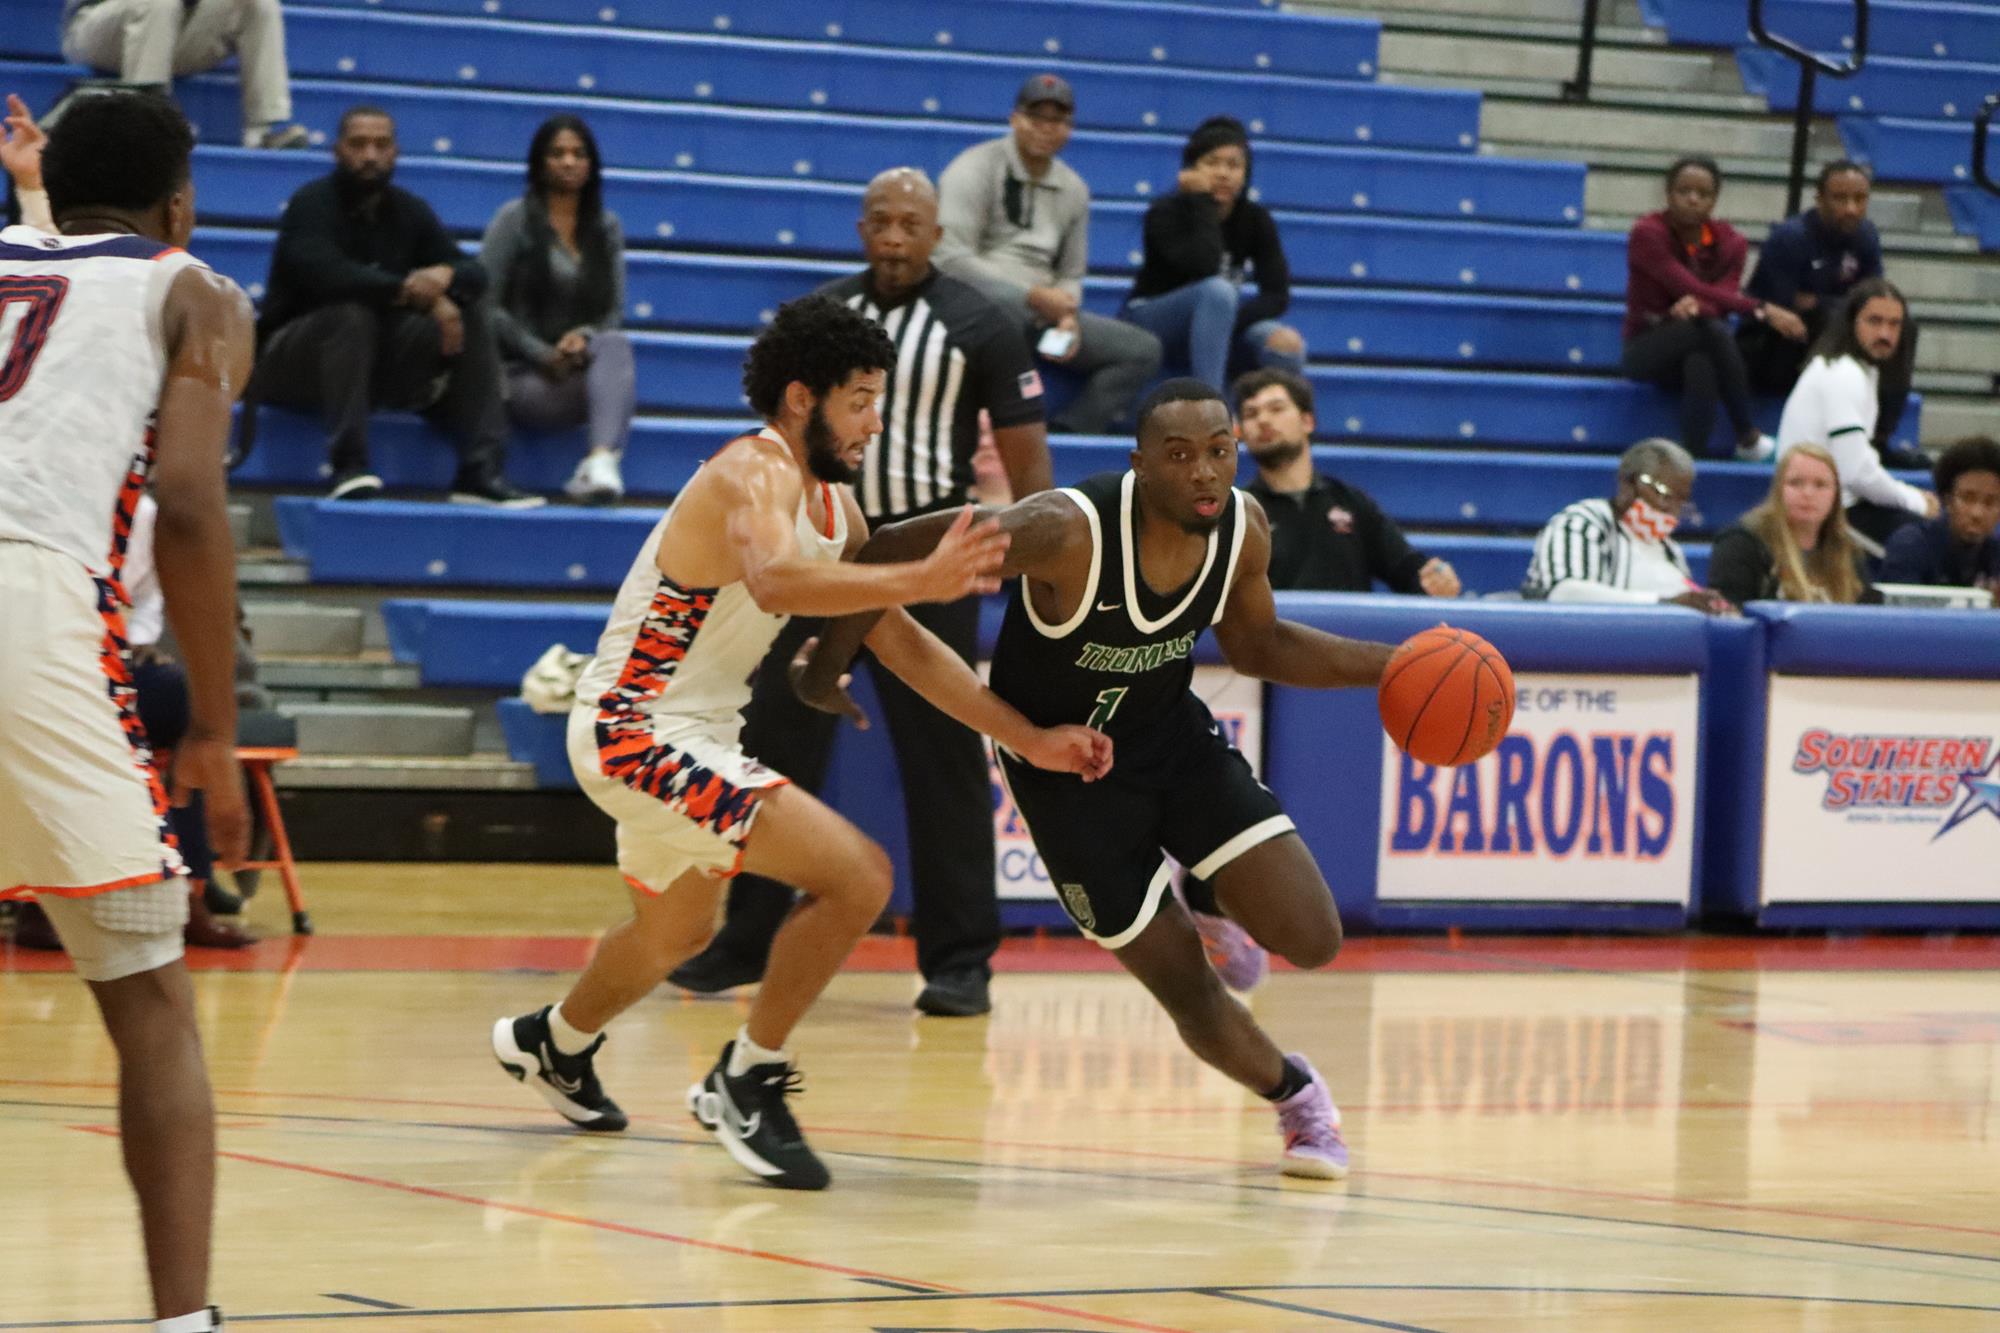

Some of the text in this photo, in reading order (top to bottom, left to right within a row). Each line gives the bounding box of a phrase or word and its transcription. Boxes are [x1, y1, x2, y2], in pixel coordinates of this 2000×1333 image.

[1075, 630, 1196, 673] THOMAS
[1536, 688, 1567, 712] OF
[1573, 689, 1617, 713] THE
[1794, 728, 1991, 774] SOUTHERN
[1389, 730, 1675, 862] BARONS
[1823, 769, 1958, 810] STATES
